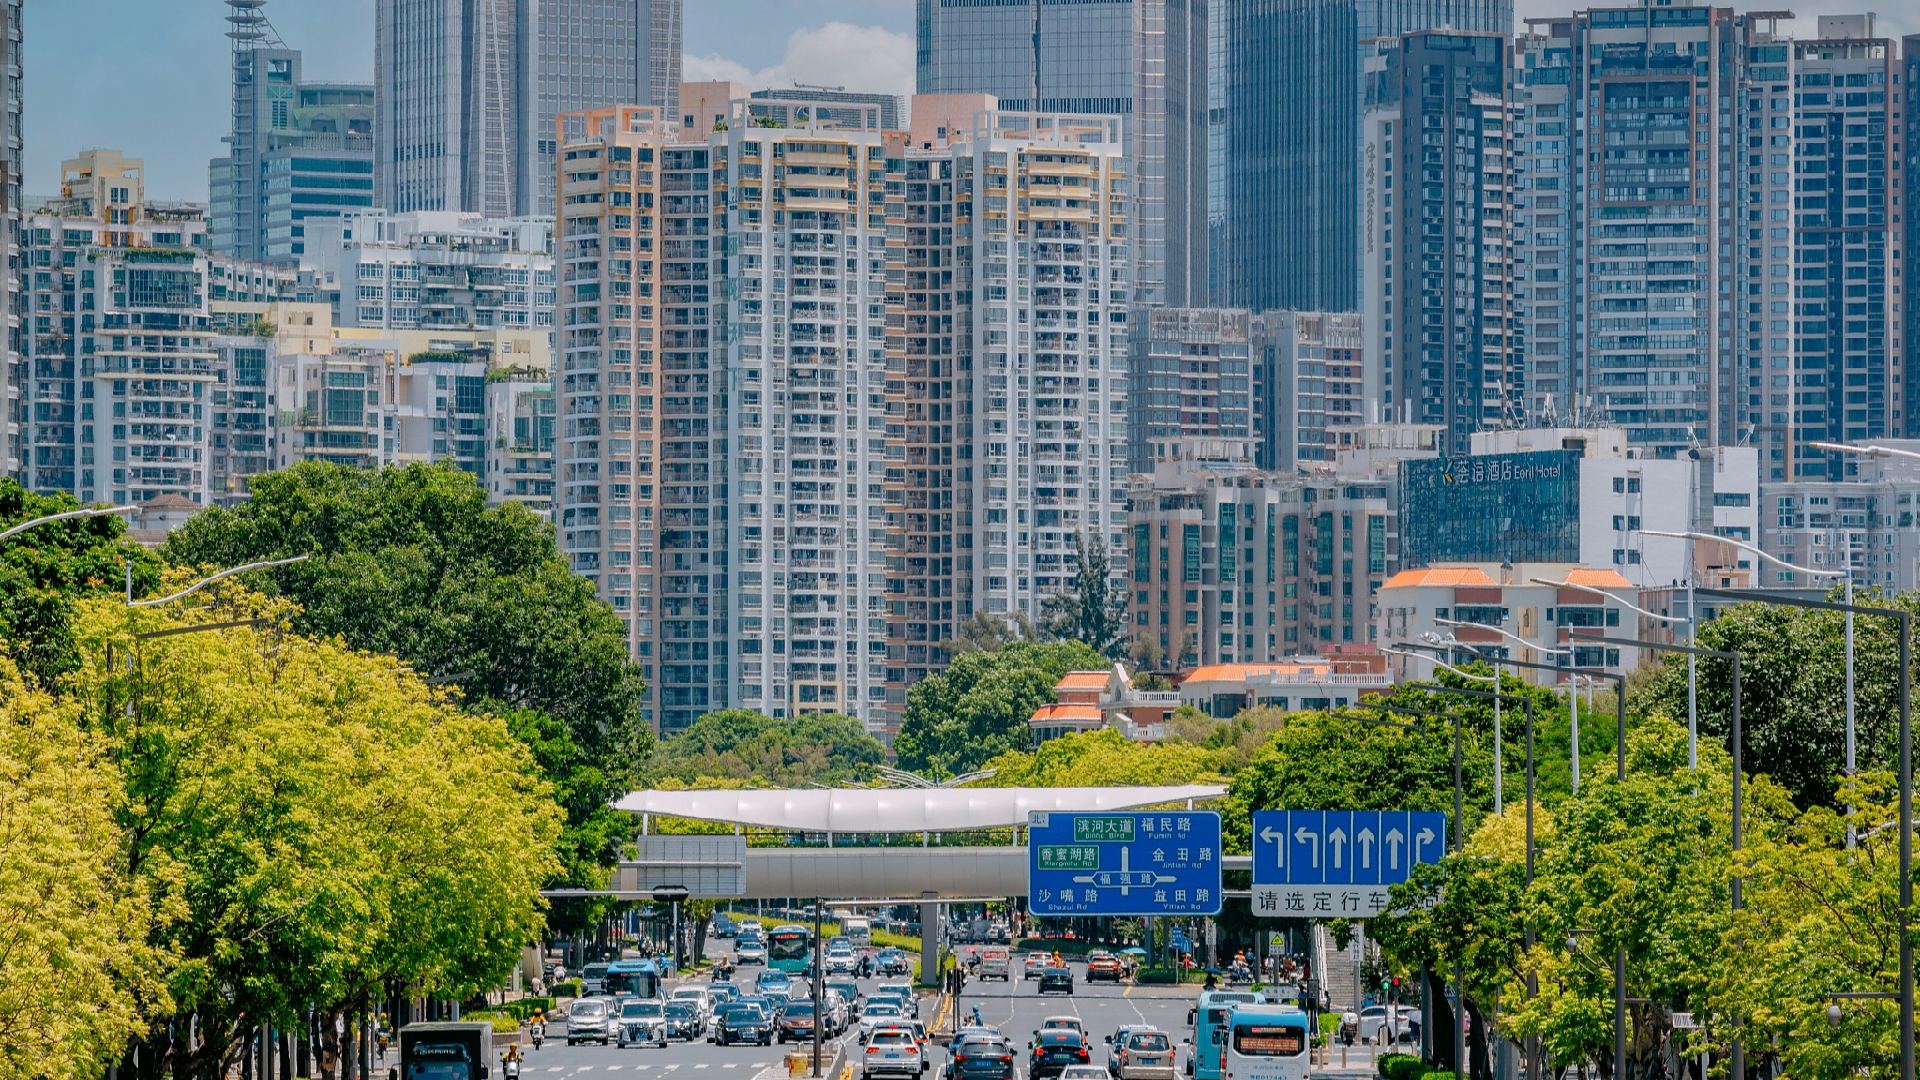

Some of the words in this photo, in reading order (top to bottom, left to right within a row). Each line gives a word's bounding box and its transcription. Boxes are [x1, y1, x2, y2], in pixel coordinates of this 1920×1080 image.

[1536, 463, 1561, 478] Hotel
[1032, 814, 1041, 824] 北
[1077, 819, 1132, 833] 滨河大道
[1141, 817, 1191, 832] 福民路
[1042, 848, 1095, 861] 香蜜湖路
[1152, 847, 1212, 862] 金田路
[1100, 873, 1151, 885] 福强路
[1038, 888, 1098, 903] 沙嘴路
[1153, 888, 1209, 902] 益田路
[1258, 891, 1439, 911] 请选定行车向
